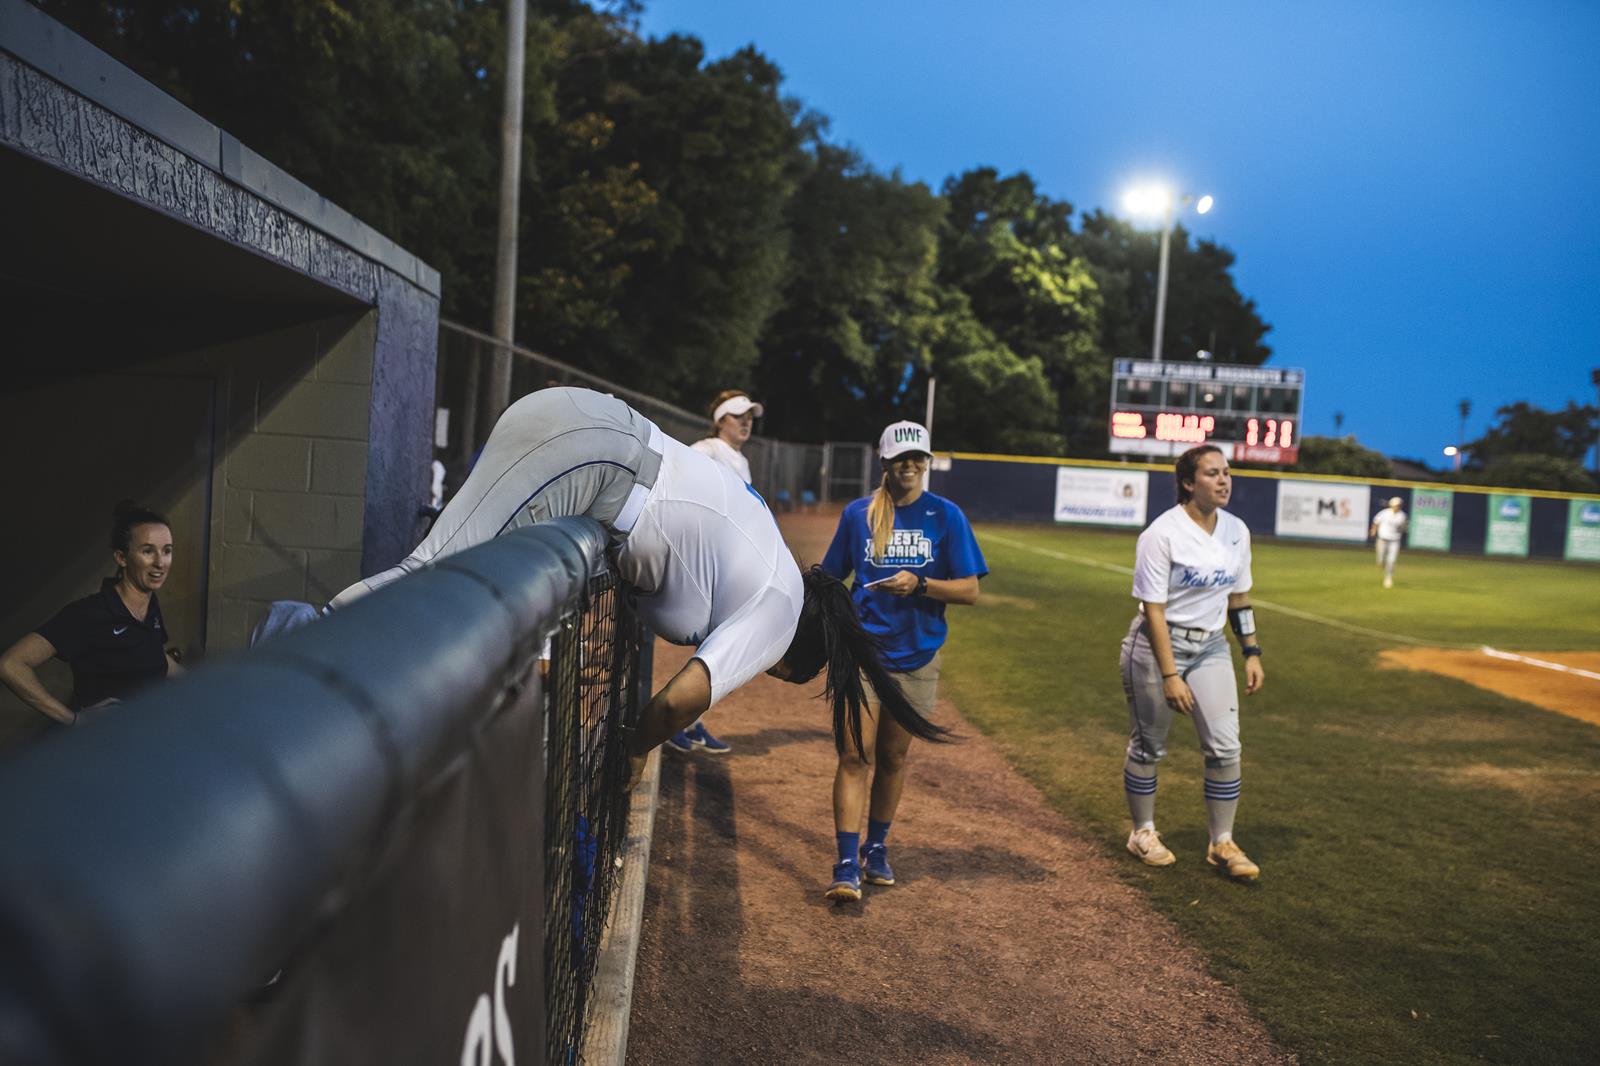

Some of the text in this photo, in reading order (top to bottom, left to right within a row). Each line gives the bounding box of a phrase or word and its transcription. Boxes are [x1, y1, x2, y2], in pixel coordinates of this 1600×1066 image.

[894, 427, 923, 443] UWF
[1317, 497, 1351, 519] MS
[869, 540, 929, 558] ORIDA
[1180, 569, 1208, 587] West
